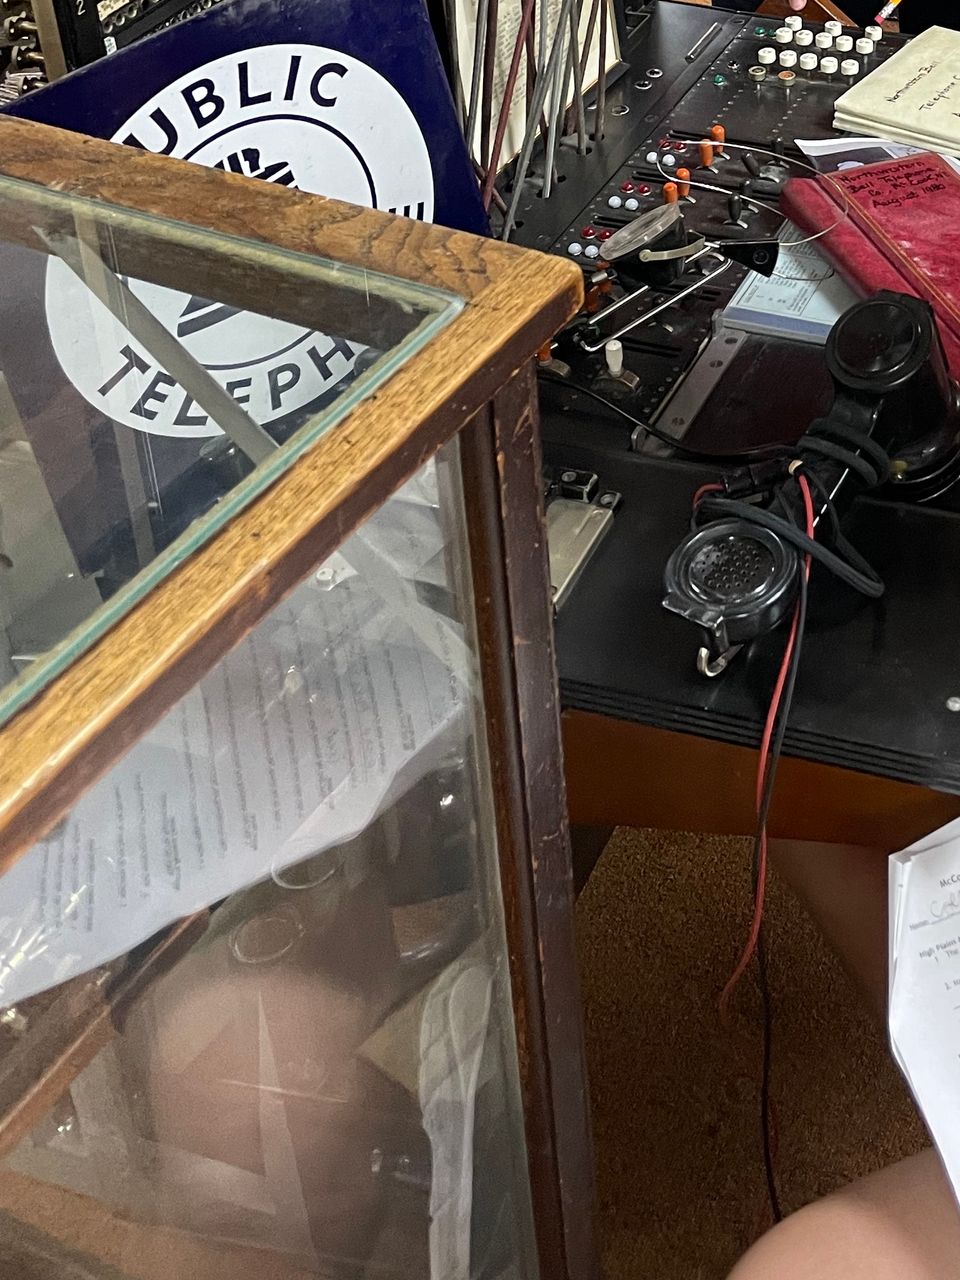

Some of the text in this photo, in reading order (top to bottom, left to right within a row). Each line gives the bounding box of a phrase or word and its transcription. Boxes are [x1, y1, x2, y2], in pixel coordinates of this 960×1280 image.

[918, 81, 956, 112] Telephone
[846, 166, 937, 194] Bell Telephone
[872, 190, 920, 209] August
